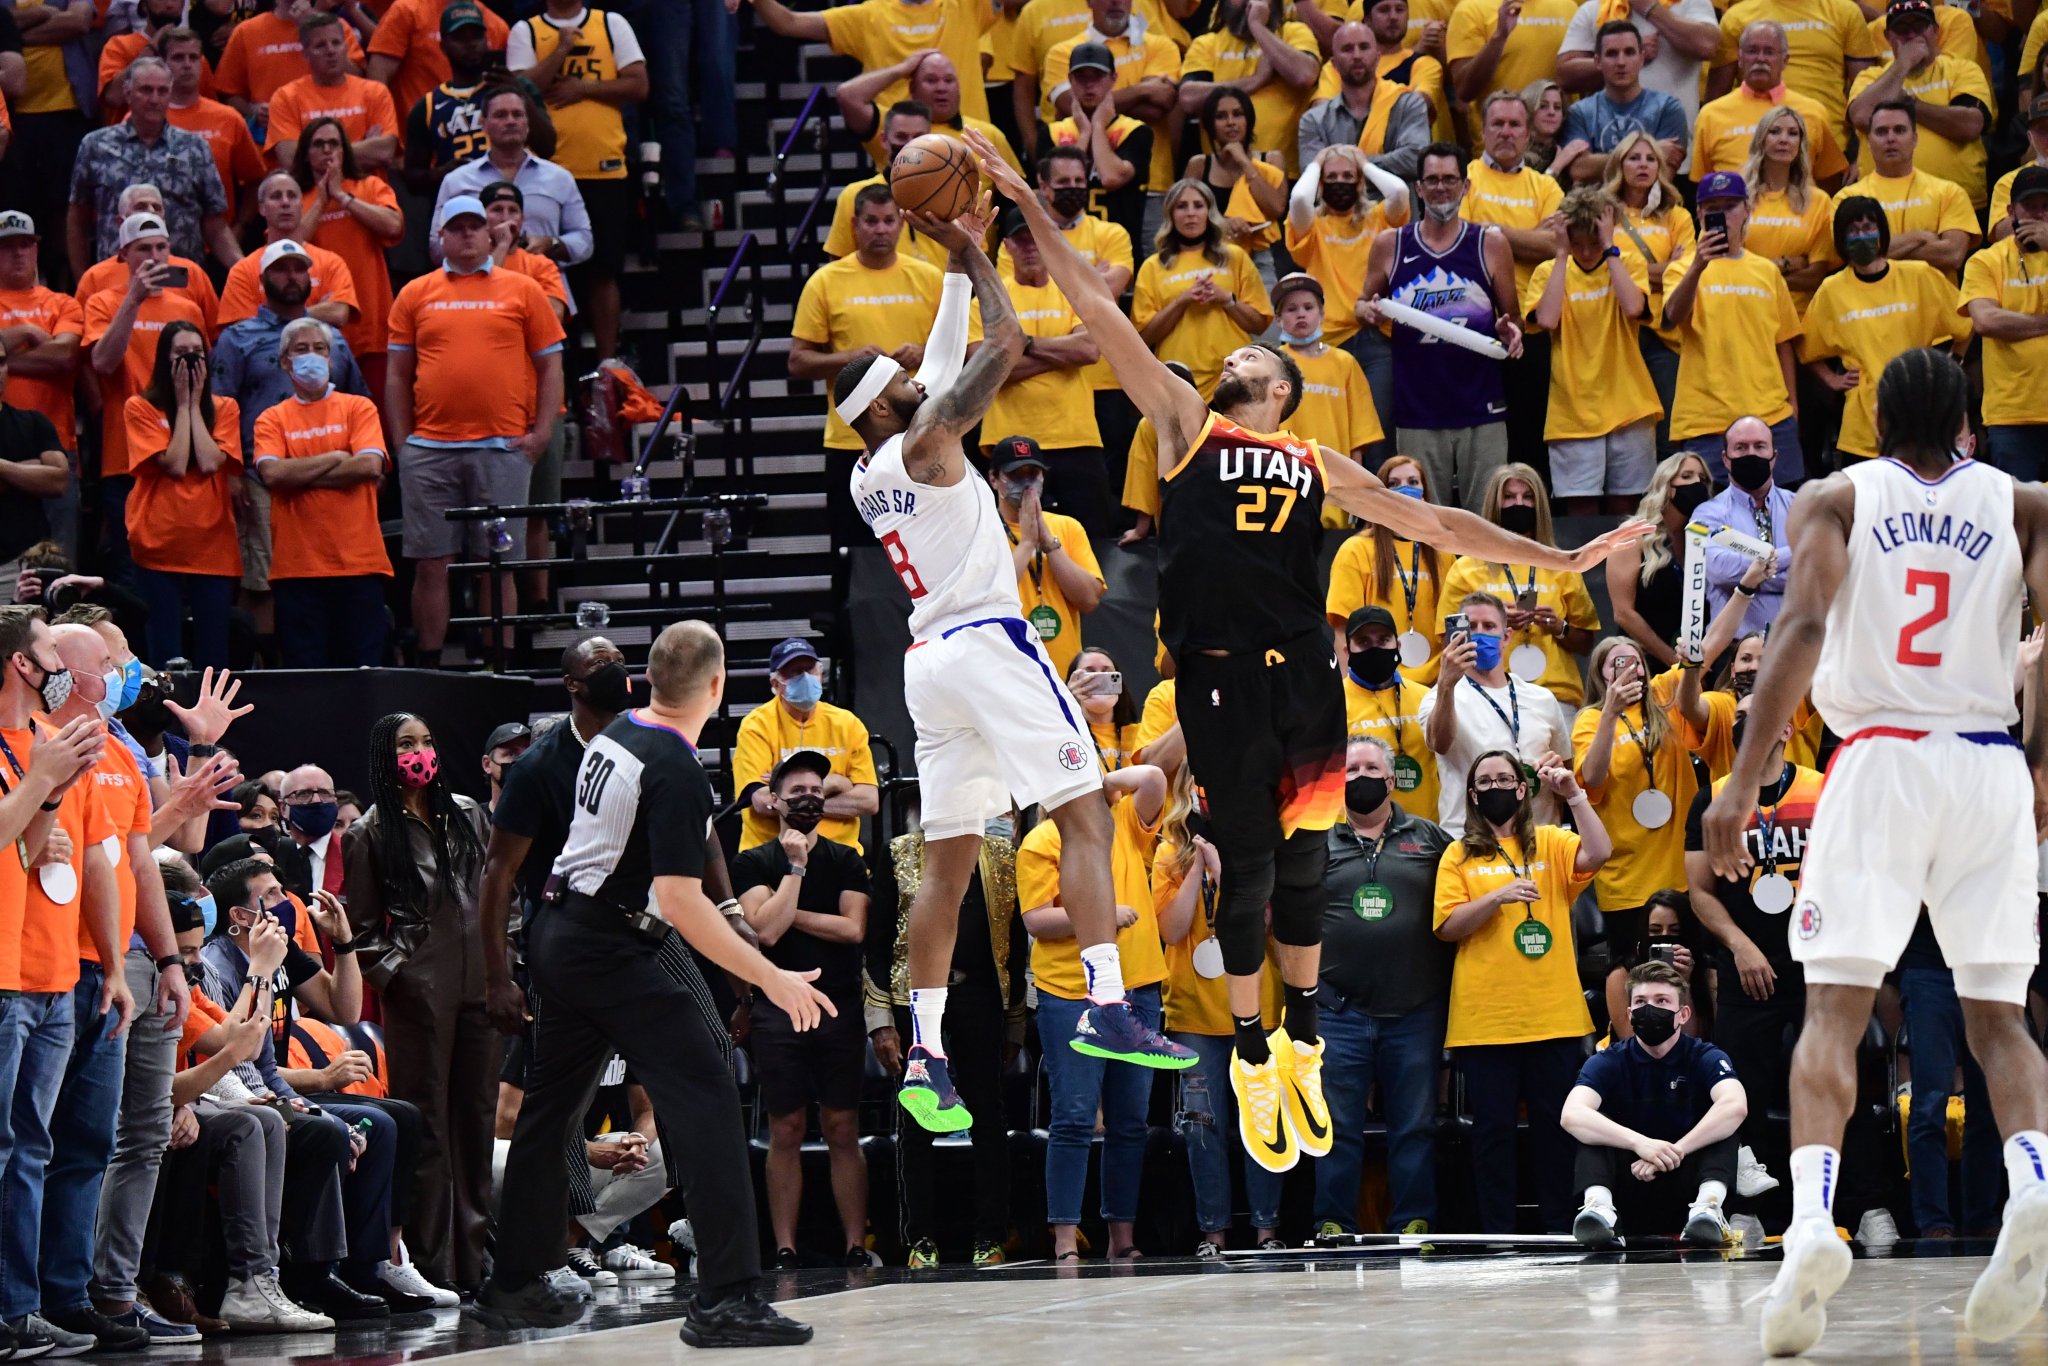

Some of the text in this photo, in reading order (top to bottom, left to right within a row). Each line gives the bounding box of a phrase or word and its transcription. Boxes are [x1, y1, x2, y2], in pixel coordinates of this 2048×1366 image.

[434, 301, 494, 310] PLAYOFFS
[853, 294, 914, 305] PLAYOFFS
[1411, 287, 1467, 311] JAZZ
[1847, 303, 1908, 321] PLAYOFFS
[1220, 447, 1313, 499] UTAH
[893, 489, 917, 517] SR.
[1236, 485, 1297, 533] 27
[1872, 513, 1993, 562] LEONARD
[881, 530, 929, 600] 8
[1690, 562, 1704, 656] GO JAZZ
[1896, 568, 1950, 667] 2
[1360, 714, 1420, 729] PLAYOFF
[578, 751, 616, 816] 30
[1742, 826, 1812, 860] TAH
